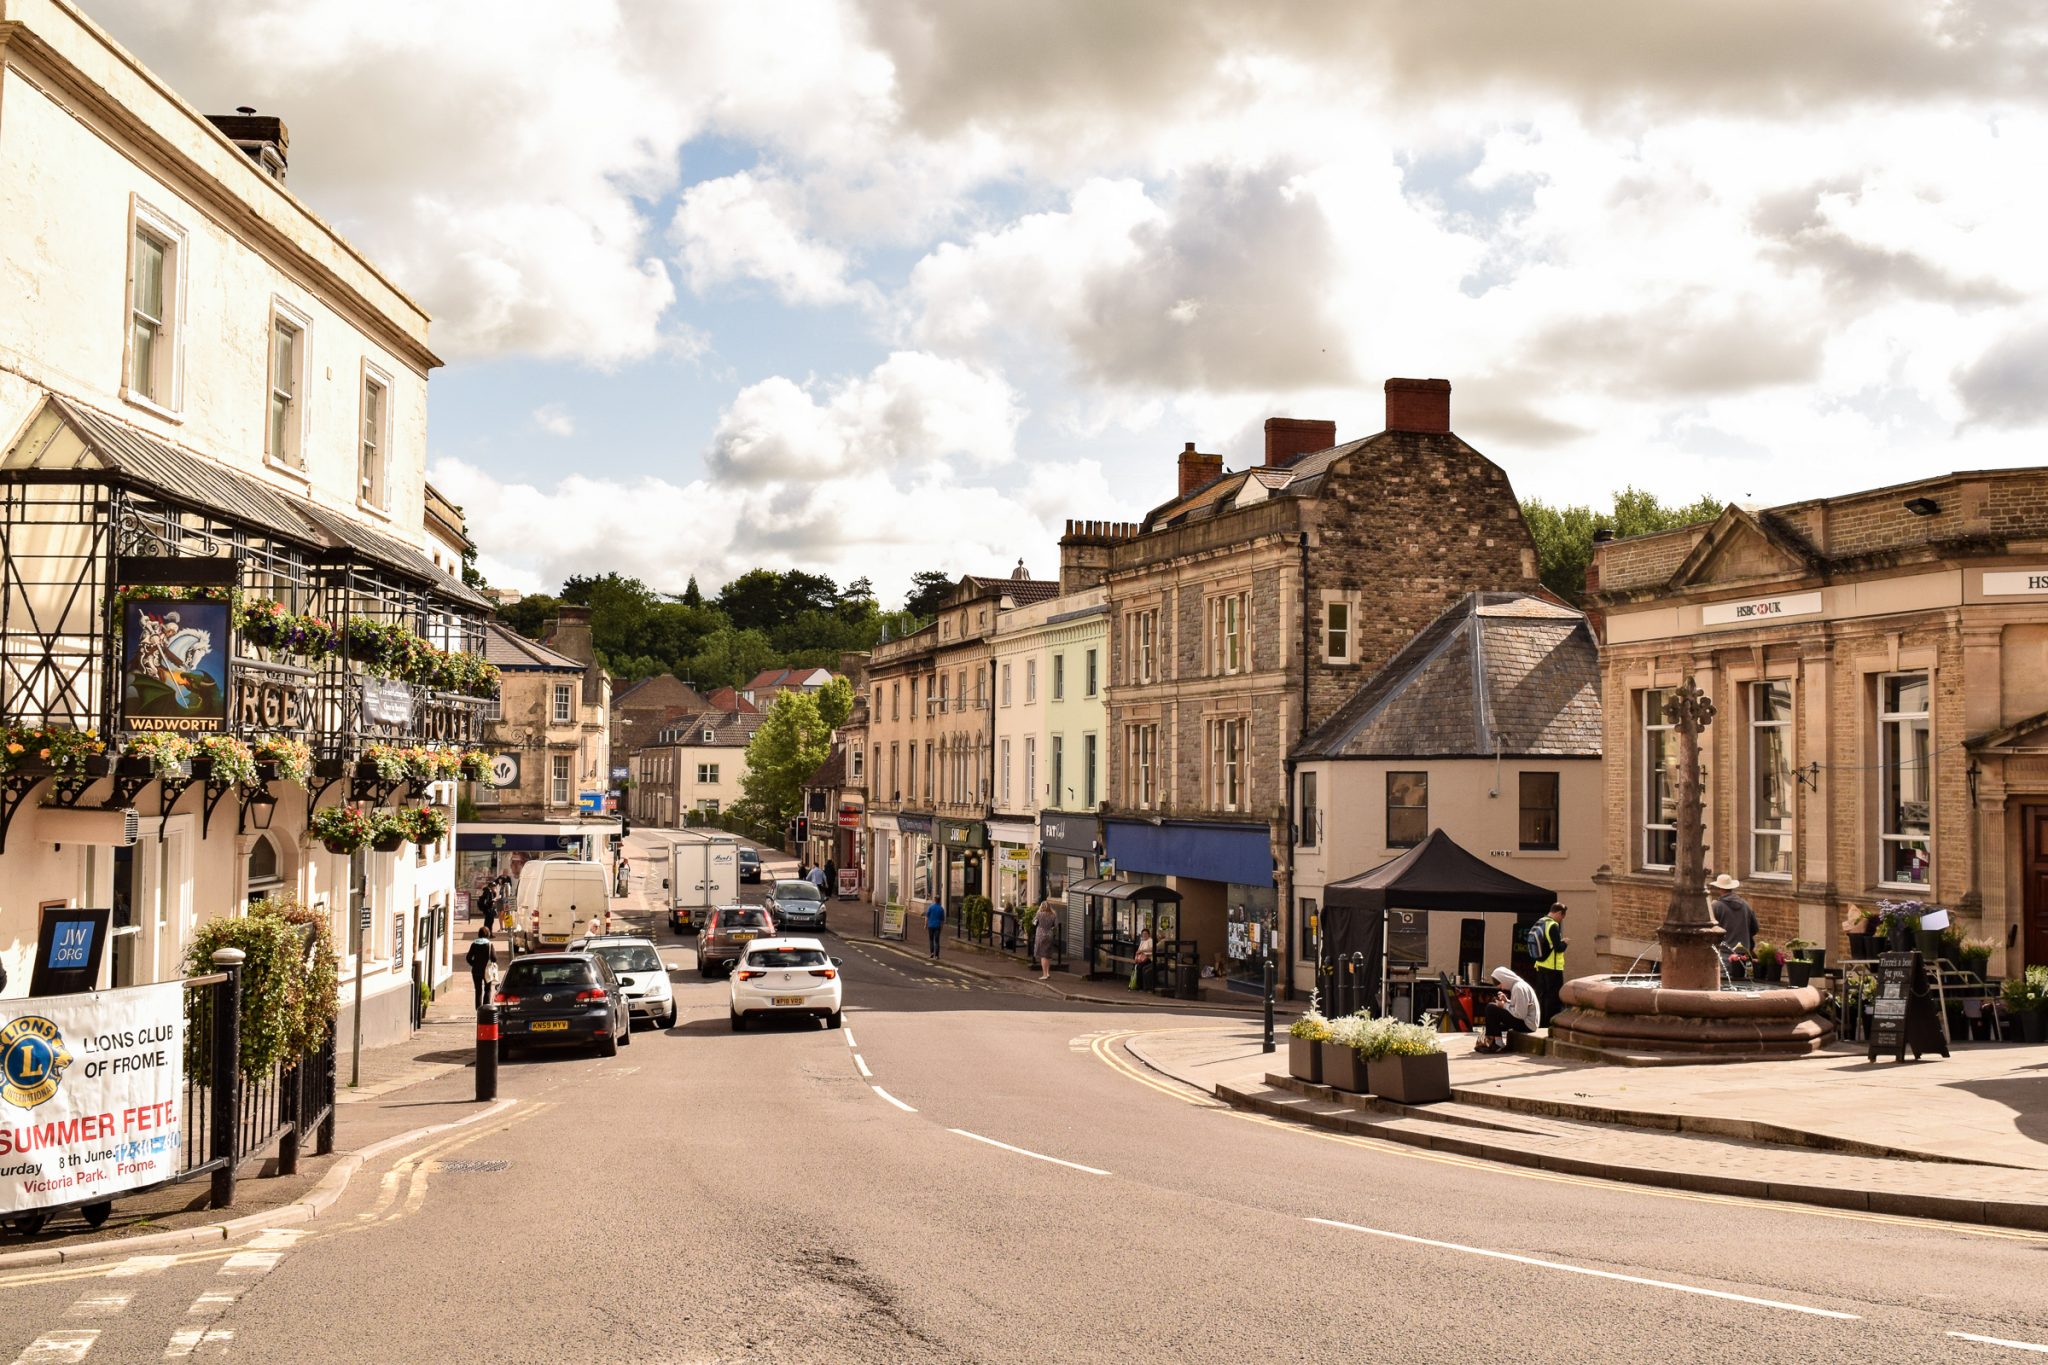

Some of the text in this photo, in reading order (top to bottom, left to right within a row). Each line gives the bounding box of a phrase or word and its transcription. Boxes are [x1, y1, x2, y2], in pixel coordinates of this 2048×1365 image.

[1737, 602, 1781, 617] HSBC UK
[130, 719, 218, 731] WADWORTH
[60, 929, 87, 946] JW
[55, 948, 83, 961] .ORG
[5, 1020, 53, 1041] LIONS
[84, 1025, 173, 1053] LIONS CLUB
[20, 1045, 43, 1078] L
[85, 1051, 168, 1078] OF FROME.
[0, 1113, 115, 1156] SUMMER
[123, 1100, 177, 1133] FETE.
[0, 1149, 116, 1176] urday 8 th June.
[24, 1160, 156, 1193] Victoria Park. Frome.
